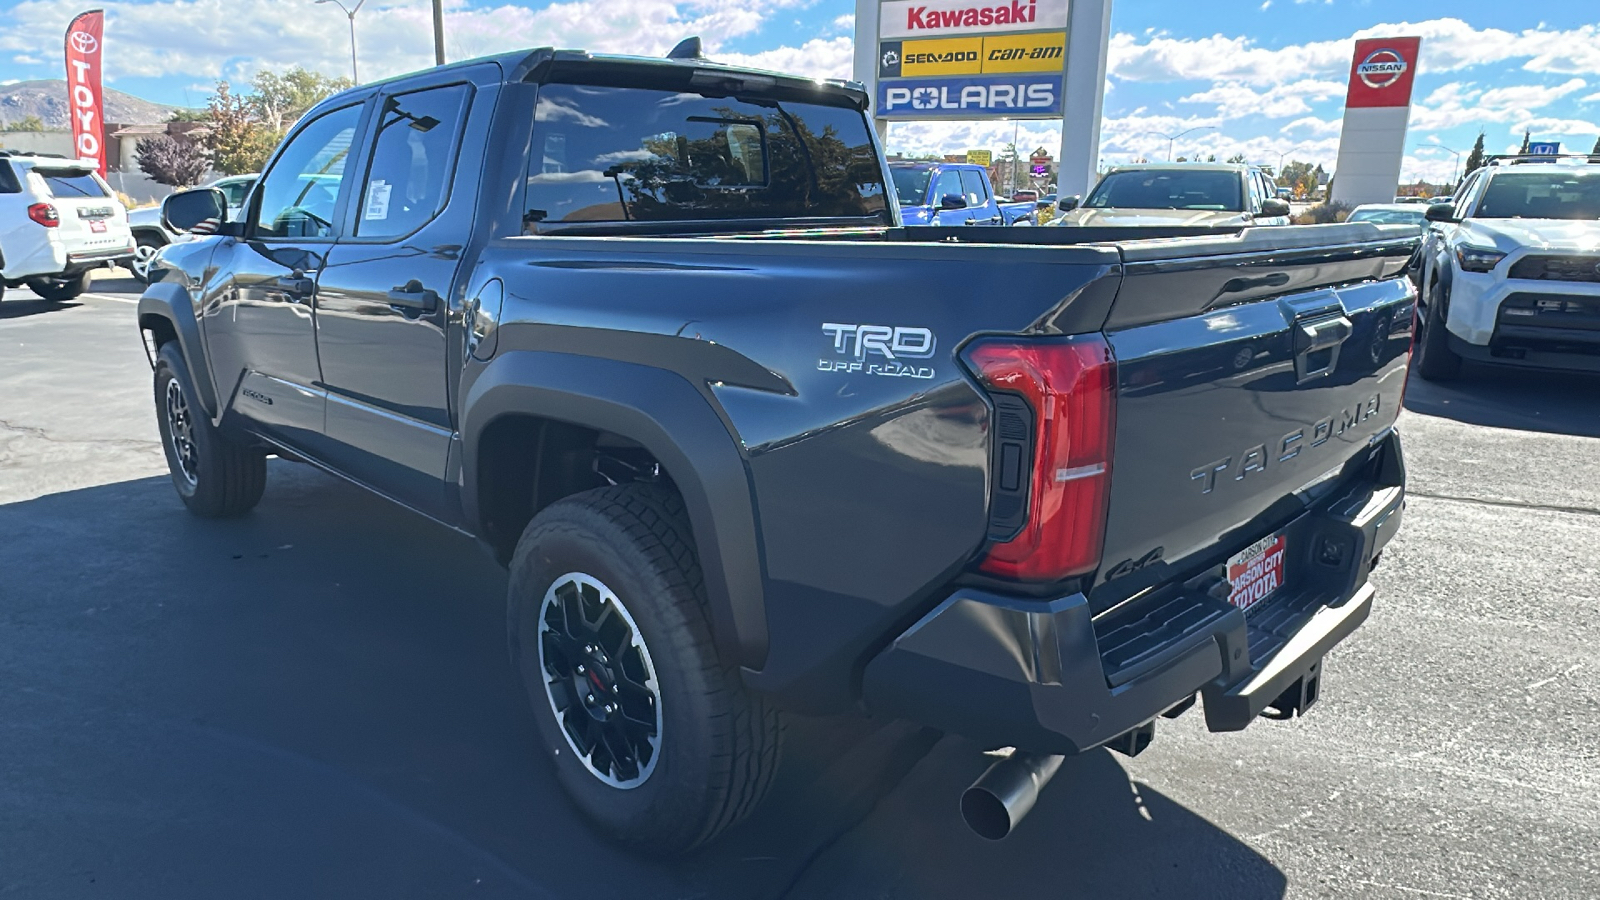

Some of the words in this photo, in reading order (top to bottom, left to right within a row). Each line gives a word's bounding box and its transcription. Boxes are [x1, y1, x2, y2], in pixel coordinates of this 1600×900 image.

[907, 0, 1036, 30] Kawasaki
[1361, 64, 1402, 73] NISSAN
[886, 83, 1055, 111] POLARIS
[821, 322, 937, 362] TRD
[817, 359, 863, 374] OFF
[865, 364, 936, 380] ROAD
[1190, 393, 1382, 494] TACOMA
[1264, 548, 1284, 573] CITY
[1234, 569, 1278, 610] TOYOTA
